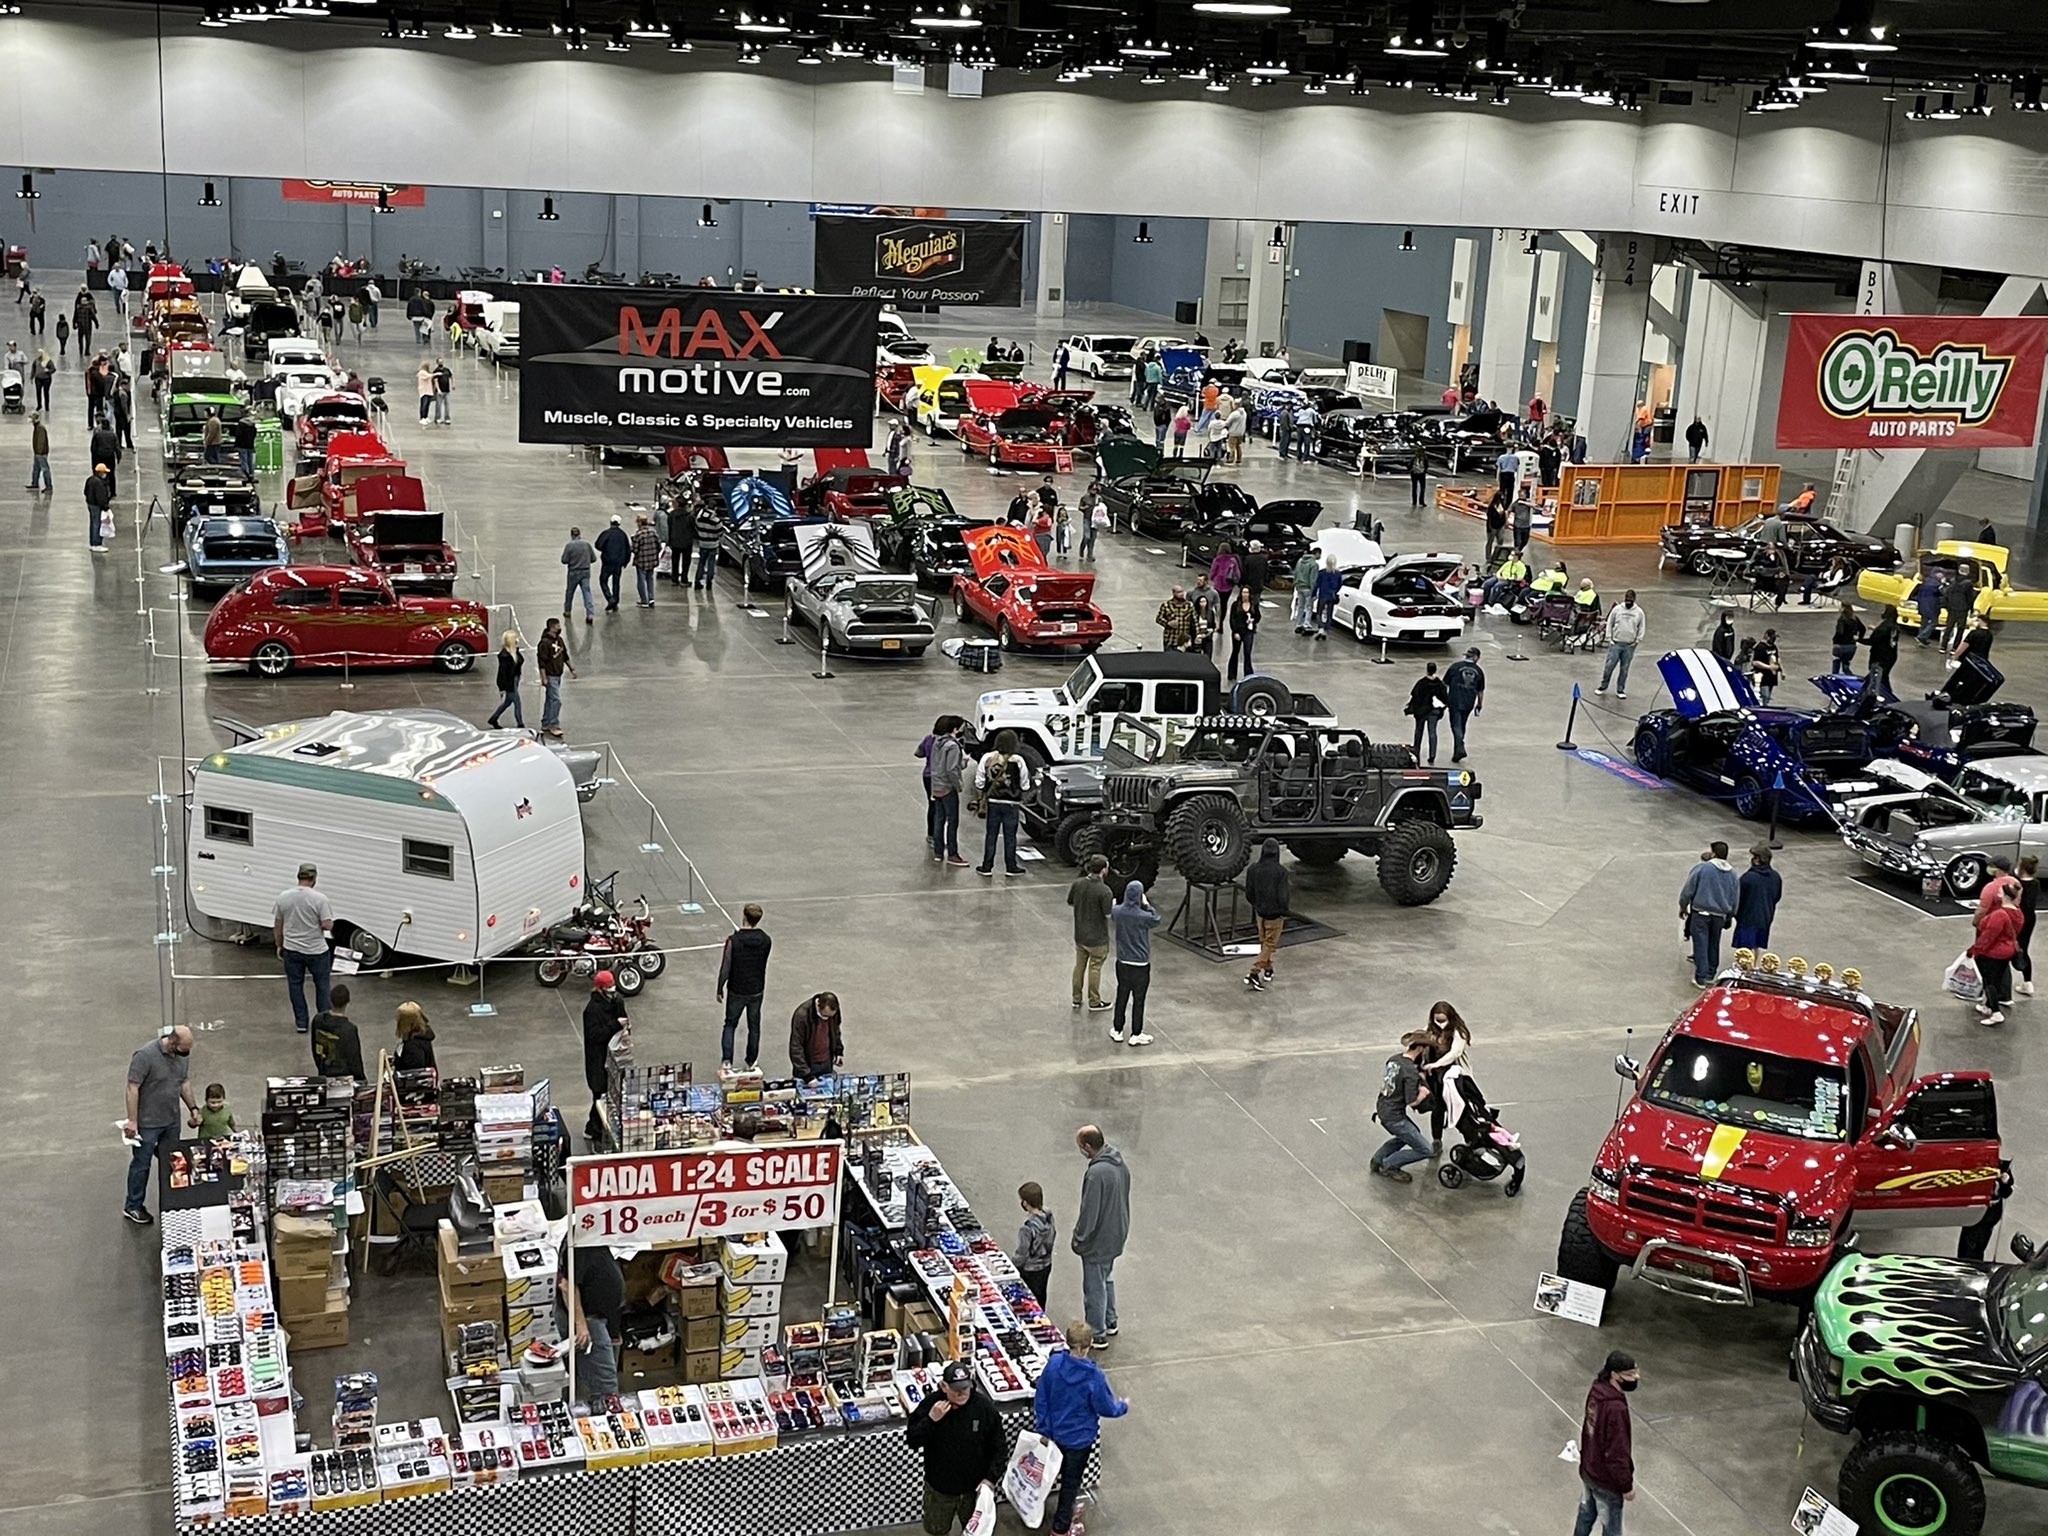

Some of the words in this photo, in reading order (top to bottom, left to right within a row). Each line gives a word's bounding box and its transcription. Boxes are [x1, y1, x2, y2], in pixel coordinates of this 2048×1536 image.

[332, 189, 351, 198] AUTO
[354, 191, 380, 200] PARTS
[1659, 193, 1699, 214] EXIT
[882, 231, 957, 273] Meguiar's
[901, 287, 929, 300] Your
[931, 289, 980, 301] Passion
[619, 306, 784, 359] MAX
[1358, 366, 1387, 381] DELHI
[1829, 341, 1998, 413] O'Reilly
[544, 410, 613, 426] Muscle,
[617, 412, 680, 427] Classic
[684, 414, 698, 427] &
[702, 414, 780, 431] Specialty
[784, 416, 853, 430] Vehicles
[1869, 421, 1907, 437] AUTO
[1909, 421, 1955, 437] PARTS
[581, 1164, 657, 1200] JADA
[670, 1158, 736, 1192] 1:24
[746, 1152, 831, 1186] SCALE
[643, 1210, 685, 1226] each
[731, 1205, 759, 1220] for
